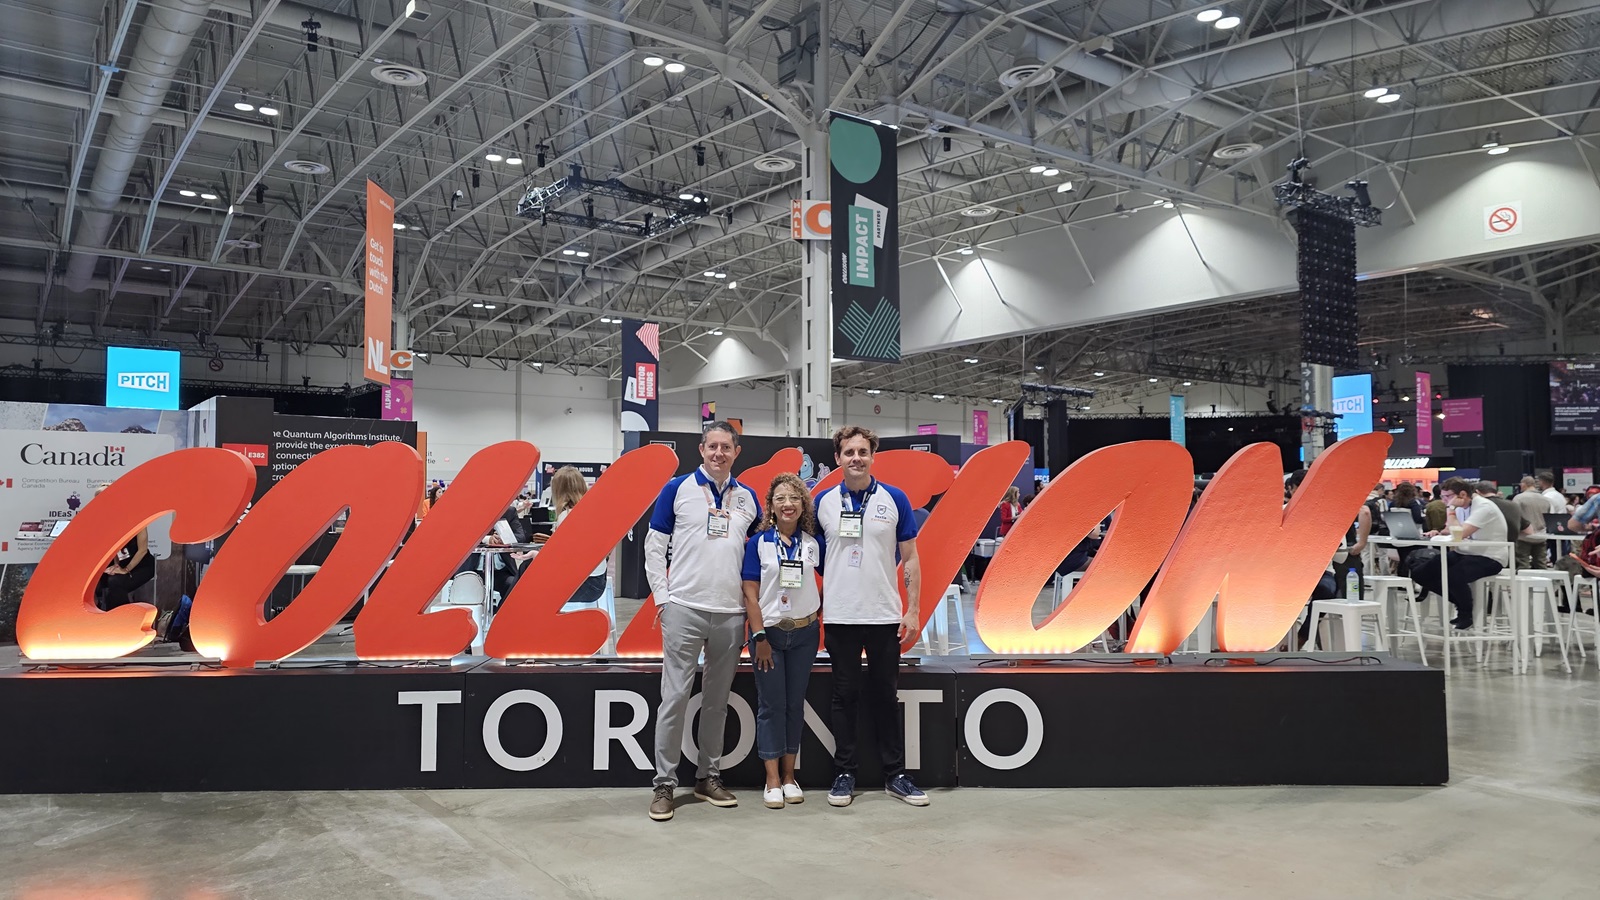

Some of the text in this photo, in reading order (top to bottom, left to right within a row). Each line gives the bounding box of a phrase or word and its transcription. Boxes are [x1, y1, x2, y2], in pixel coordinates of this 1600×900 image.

[793, 201, 801, 239] HALL
[855, 213, 869, 279] IMPACT
[369, 252, 384, 268] touch
[369, 279, 384, 296] Dutch
[367, 336, 388, 375] NL
[390, 351, 412, 369] C
[121, 375, 167, 390] PITCH
[638, 365, 646, 397] MENTOR
[646, 371, 654, 397] HOURS
[384, 389, 392, 410] ALPHA
[1333, 398, 1362, 411] ITCH
[282, 429, 322, 440] Quantum
[323, 431, 367, 441] Algorithms
[368, 433, 402, 442] Institute,
[275, 441, 308, 450] provide
[309, 441, 324, 450] the
[20, 442, 125, 467] Canada
[21, 477, 58, 485] Competition
[48, 510, 72, 518] IDEaS
